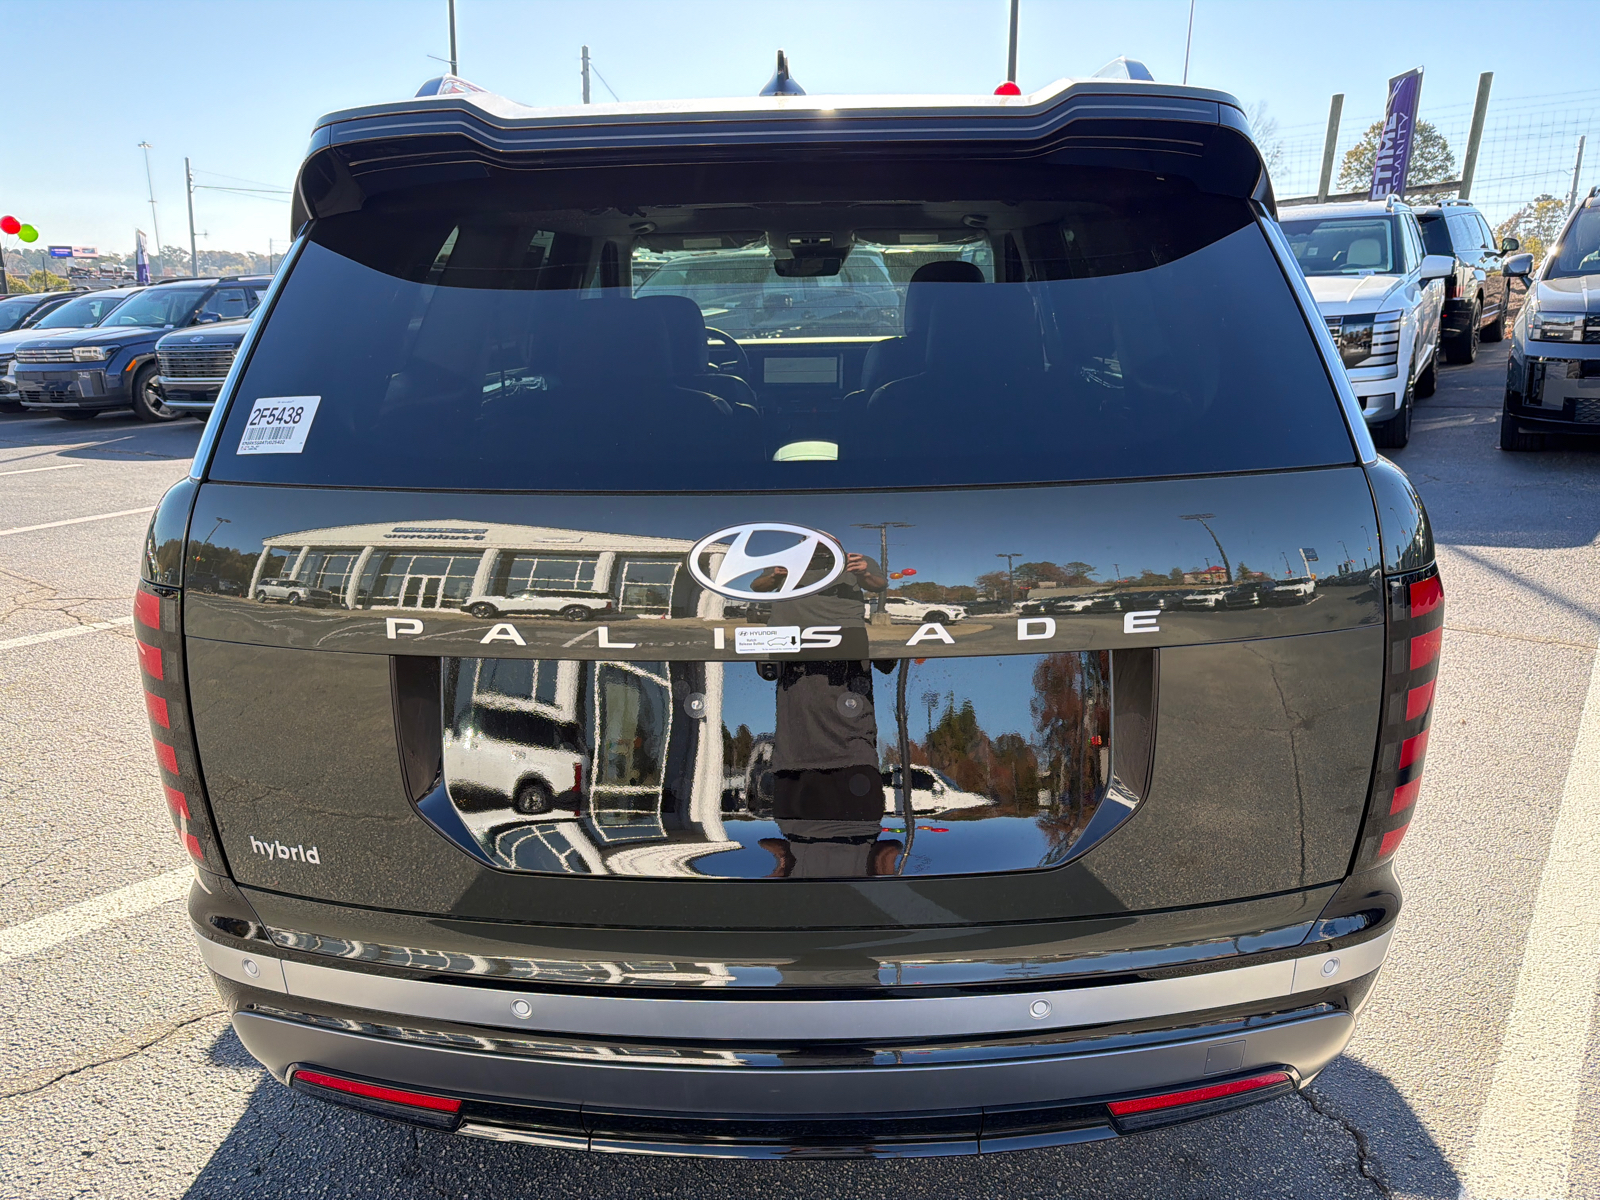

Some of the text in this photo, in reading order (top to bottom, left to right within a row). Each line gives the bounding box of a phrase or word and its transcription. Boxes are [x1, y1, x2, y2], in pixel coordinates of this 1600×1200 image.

[249, 406, 304, 426] 2F5438
[386, 610, 1161, 648] PALISADE
[249, 835, 320, 864] hybrid
